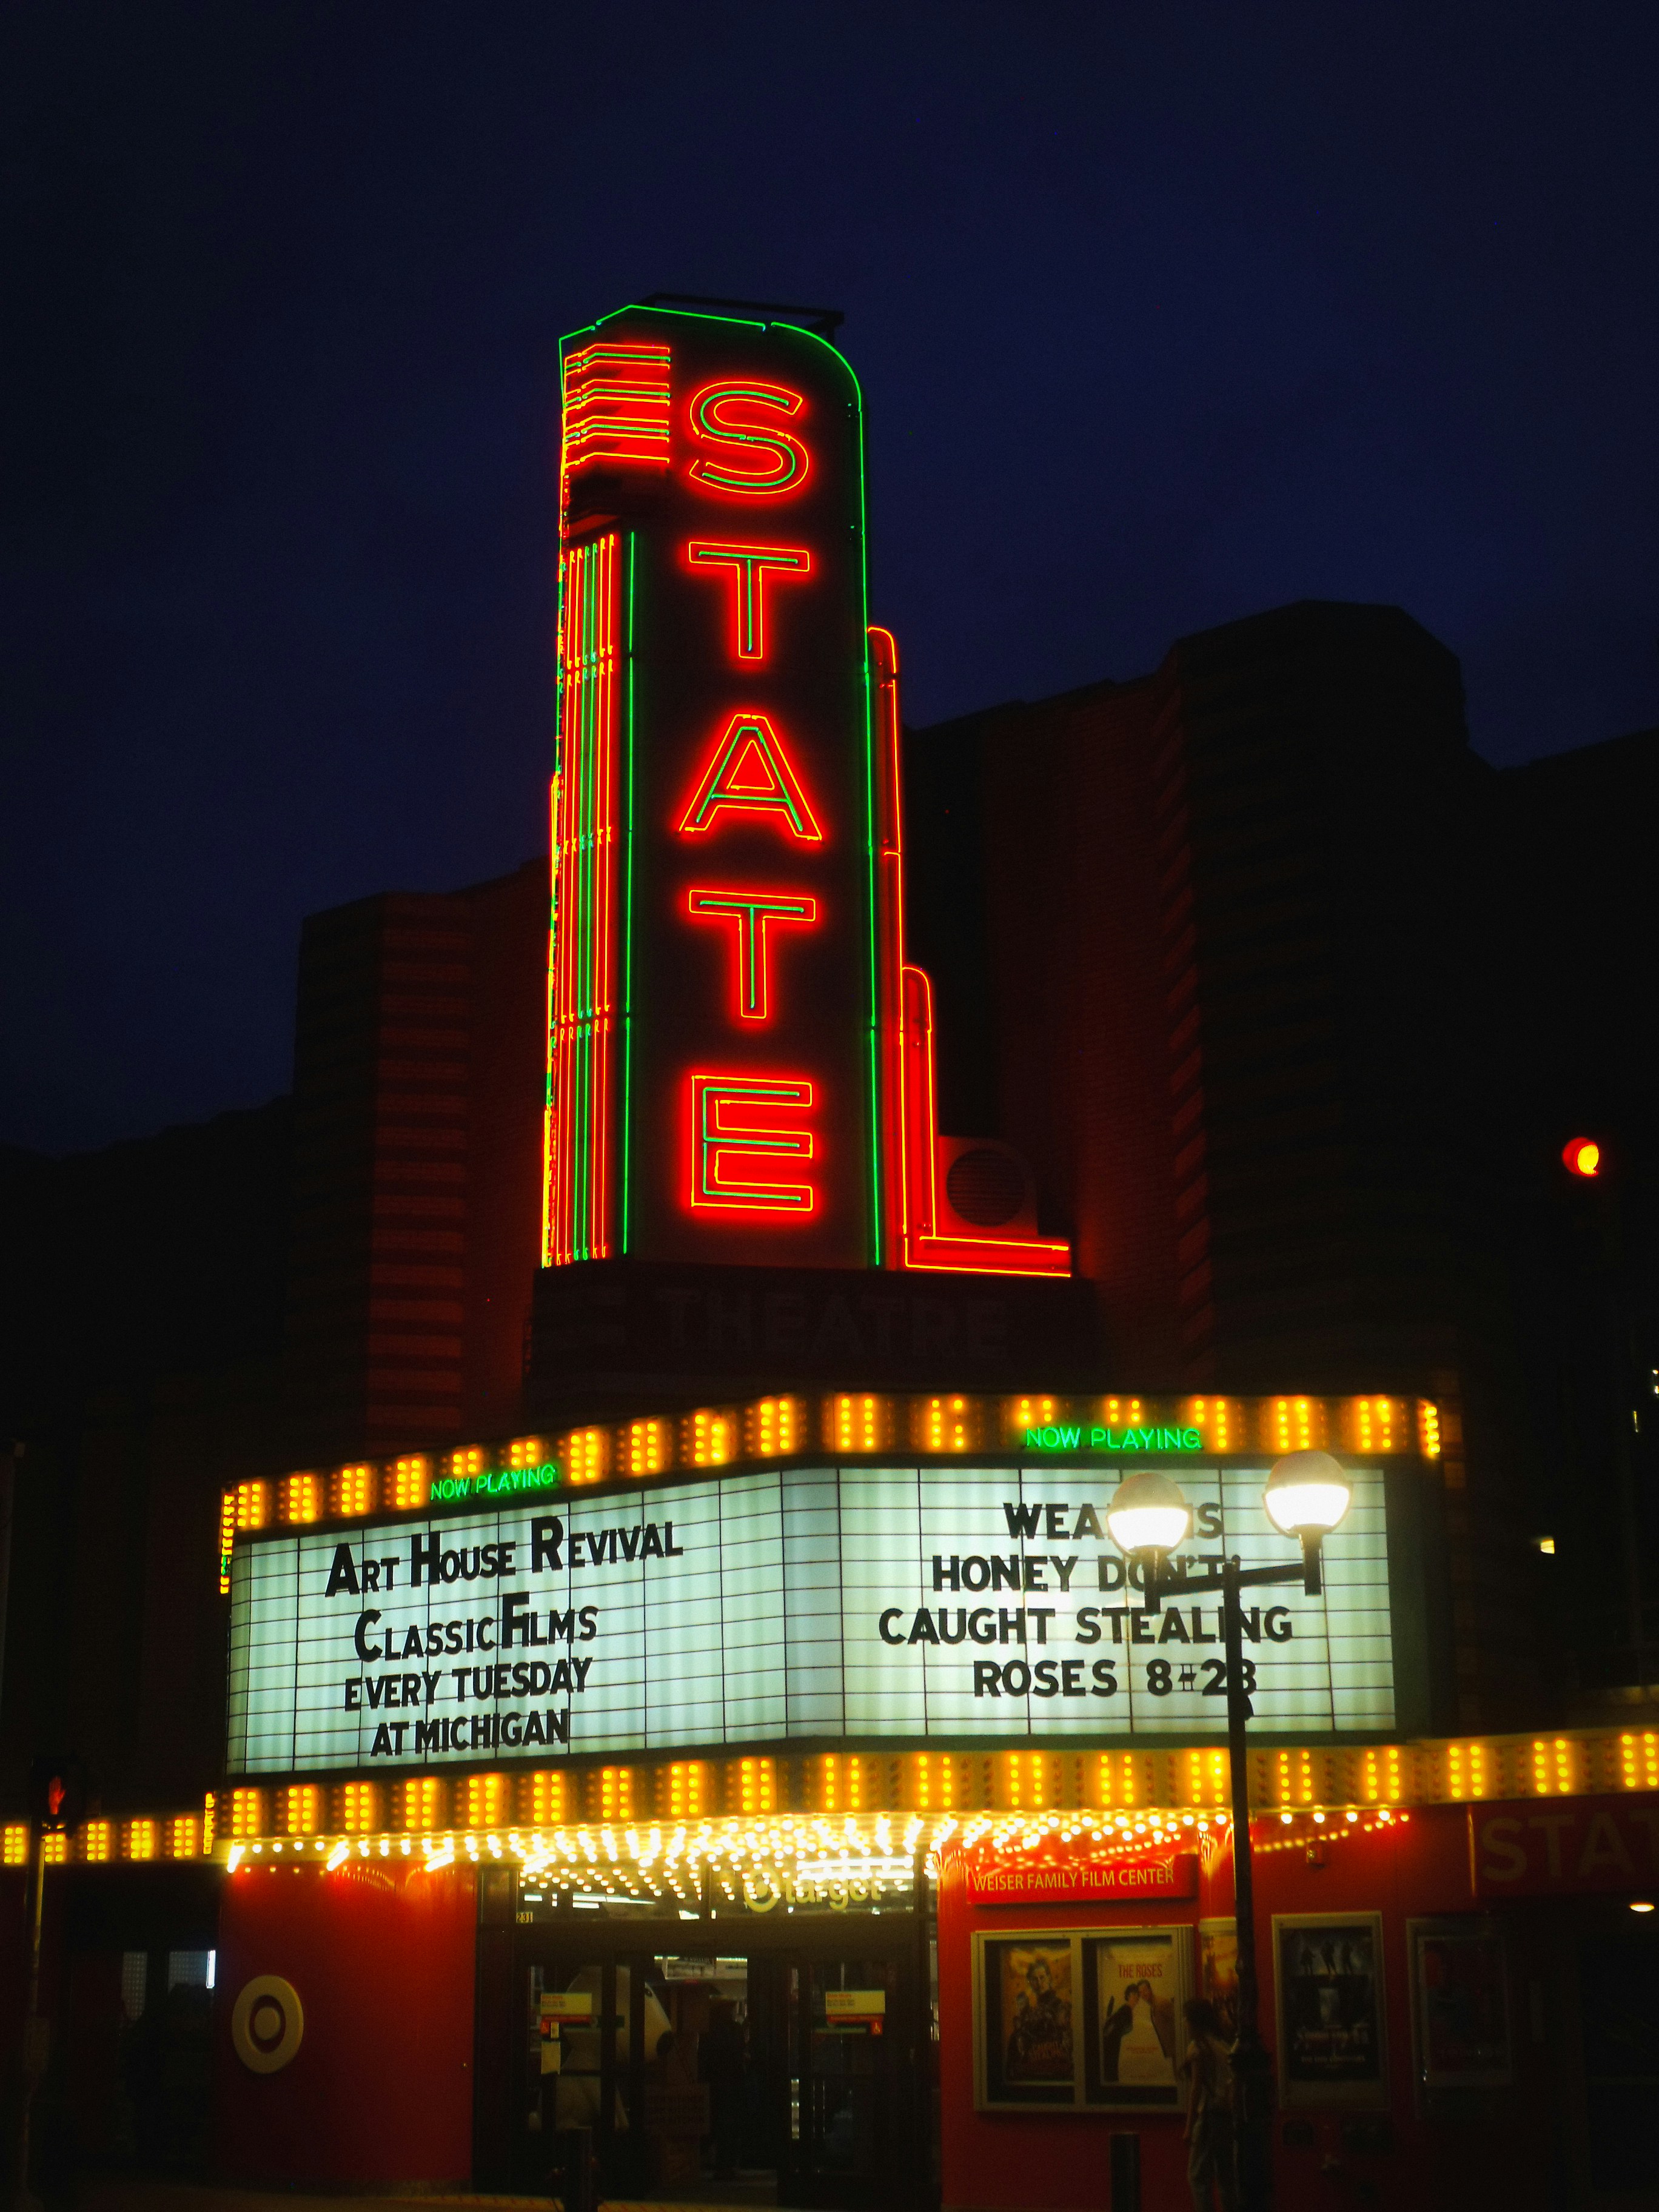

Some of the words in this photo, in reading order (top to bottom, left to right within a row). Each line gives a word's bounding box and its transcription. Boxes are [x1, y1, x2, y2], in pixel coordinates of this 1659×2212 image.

[679, 380, 823, 1212] STATE
[1026, 1426, 1081, 1449] NOW
[1091, 1427, 1203, 1450] PLAYING
[430, 1476, 471, 1501] NOW
[476, 1463, 557, 1494] PLAYING
[1003, 1503, 1224, 1540] WEAS
[325, 1542, 400, 1598] ART
[411, 1530, 517, 1587] HOUSE
[531, 1515, 683, 1574] REVIVAL
[932, 1555, 1079, 1592] HONEY
[879, 1607, 1056, 1645] CAUGHT
[1075, 1606, 1293, 1645] STEALING
[344, 1670, 442, 1712] EVERY
[452, 1657, 593, 1703] TUESDAY
[973, 1658, 1118, 1698] ROSES
[370, 1721, 410, 1757] AT
[415, 1709, 569, 1755] MICHIGAN
[785, 1871, 882, 1911] target
[974, 1874, 1024, 1892] WEISER
[1027, 1871, 1078, 1890] FAMILY
[1081, 1869, 1115, 1888] FILM
[1118, 1867, 1175, 1887] CENTER
[517, 1912, 531, 1922] 231
[1118, 1963, 1133, 1979] THE
[1136, 1963, 1163, 1979] ROSES
